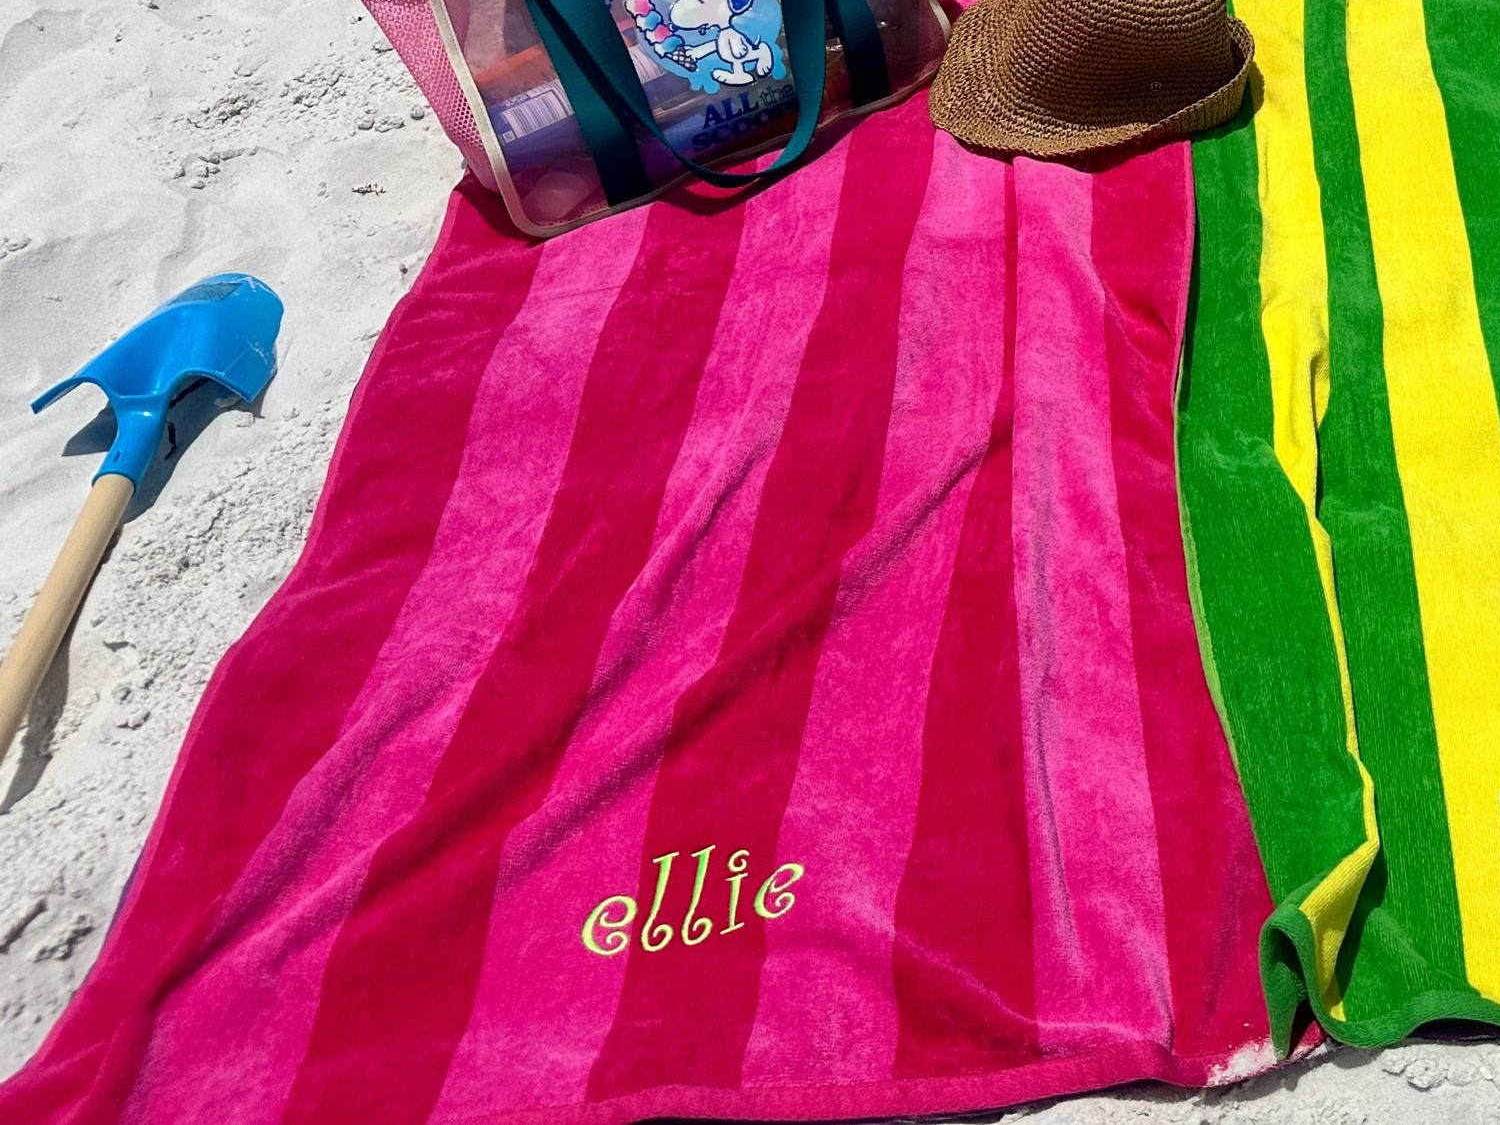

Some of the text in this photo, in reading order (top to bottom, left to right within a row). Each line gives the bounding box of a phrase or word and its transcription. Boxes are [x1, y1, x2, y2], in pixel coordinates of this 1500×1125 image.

[702, 83, 796, 130] ALL the
[580, 844, 805, 956] ellie
